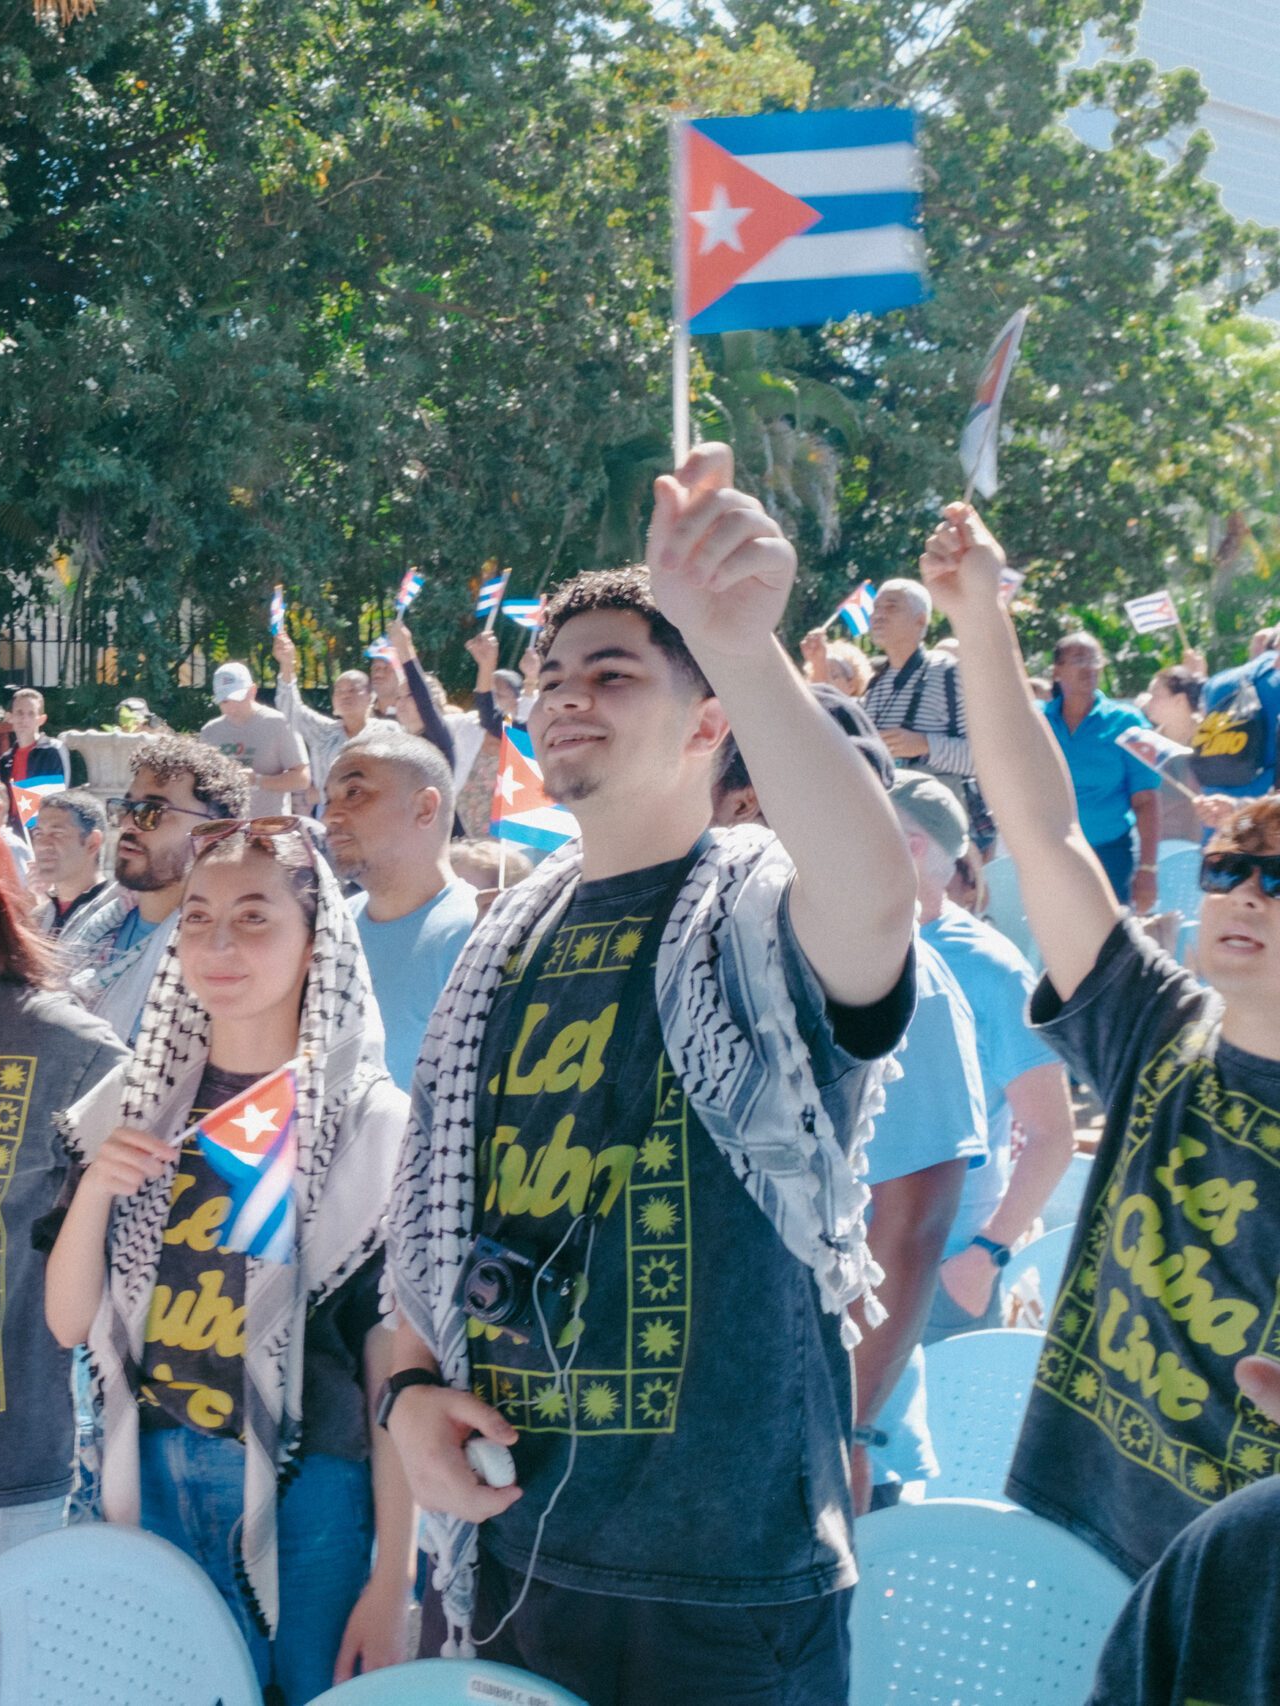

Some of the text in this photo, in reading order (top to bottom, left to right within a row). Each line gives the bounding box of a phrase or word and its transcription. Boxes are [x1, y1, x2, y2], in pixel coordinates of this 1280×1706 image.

[487, 1002, 619, 1094] Let
[1156, 1134, 1259, 1245] Let
[144, 1269, 249, 1358] uba
[1113, 1193, 1259, 1356] Cuba
[1099, 1287, 1209, 1421] Live
